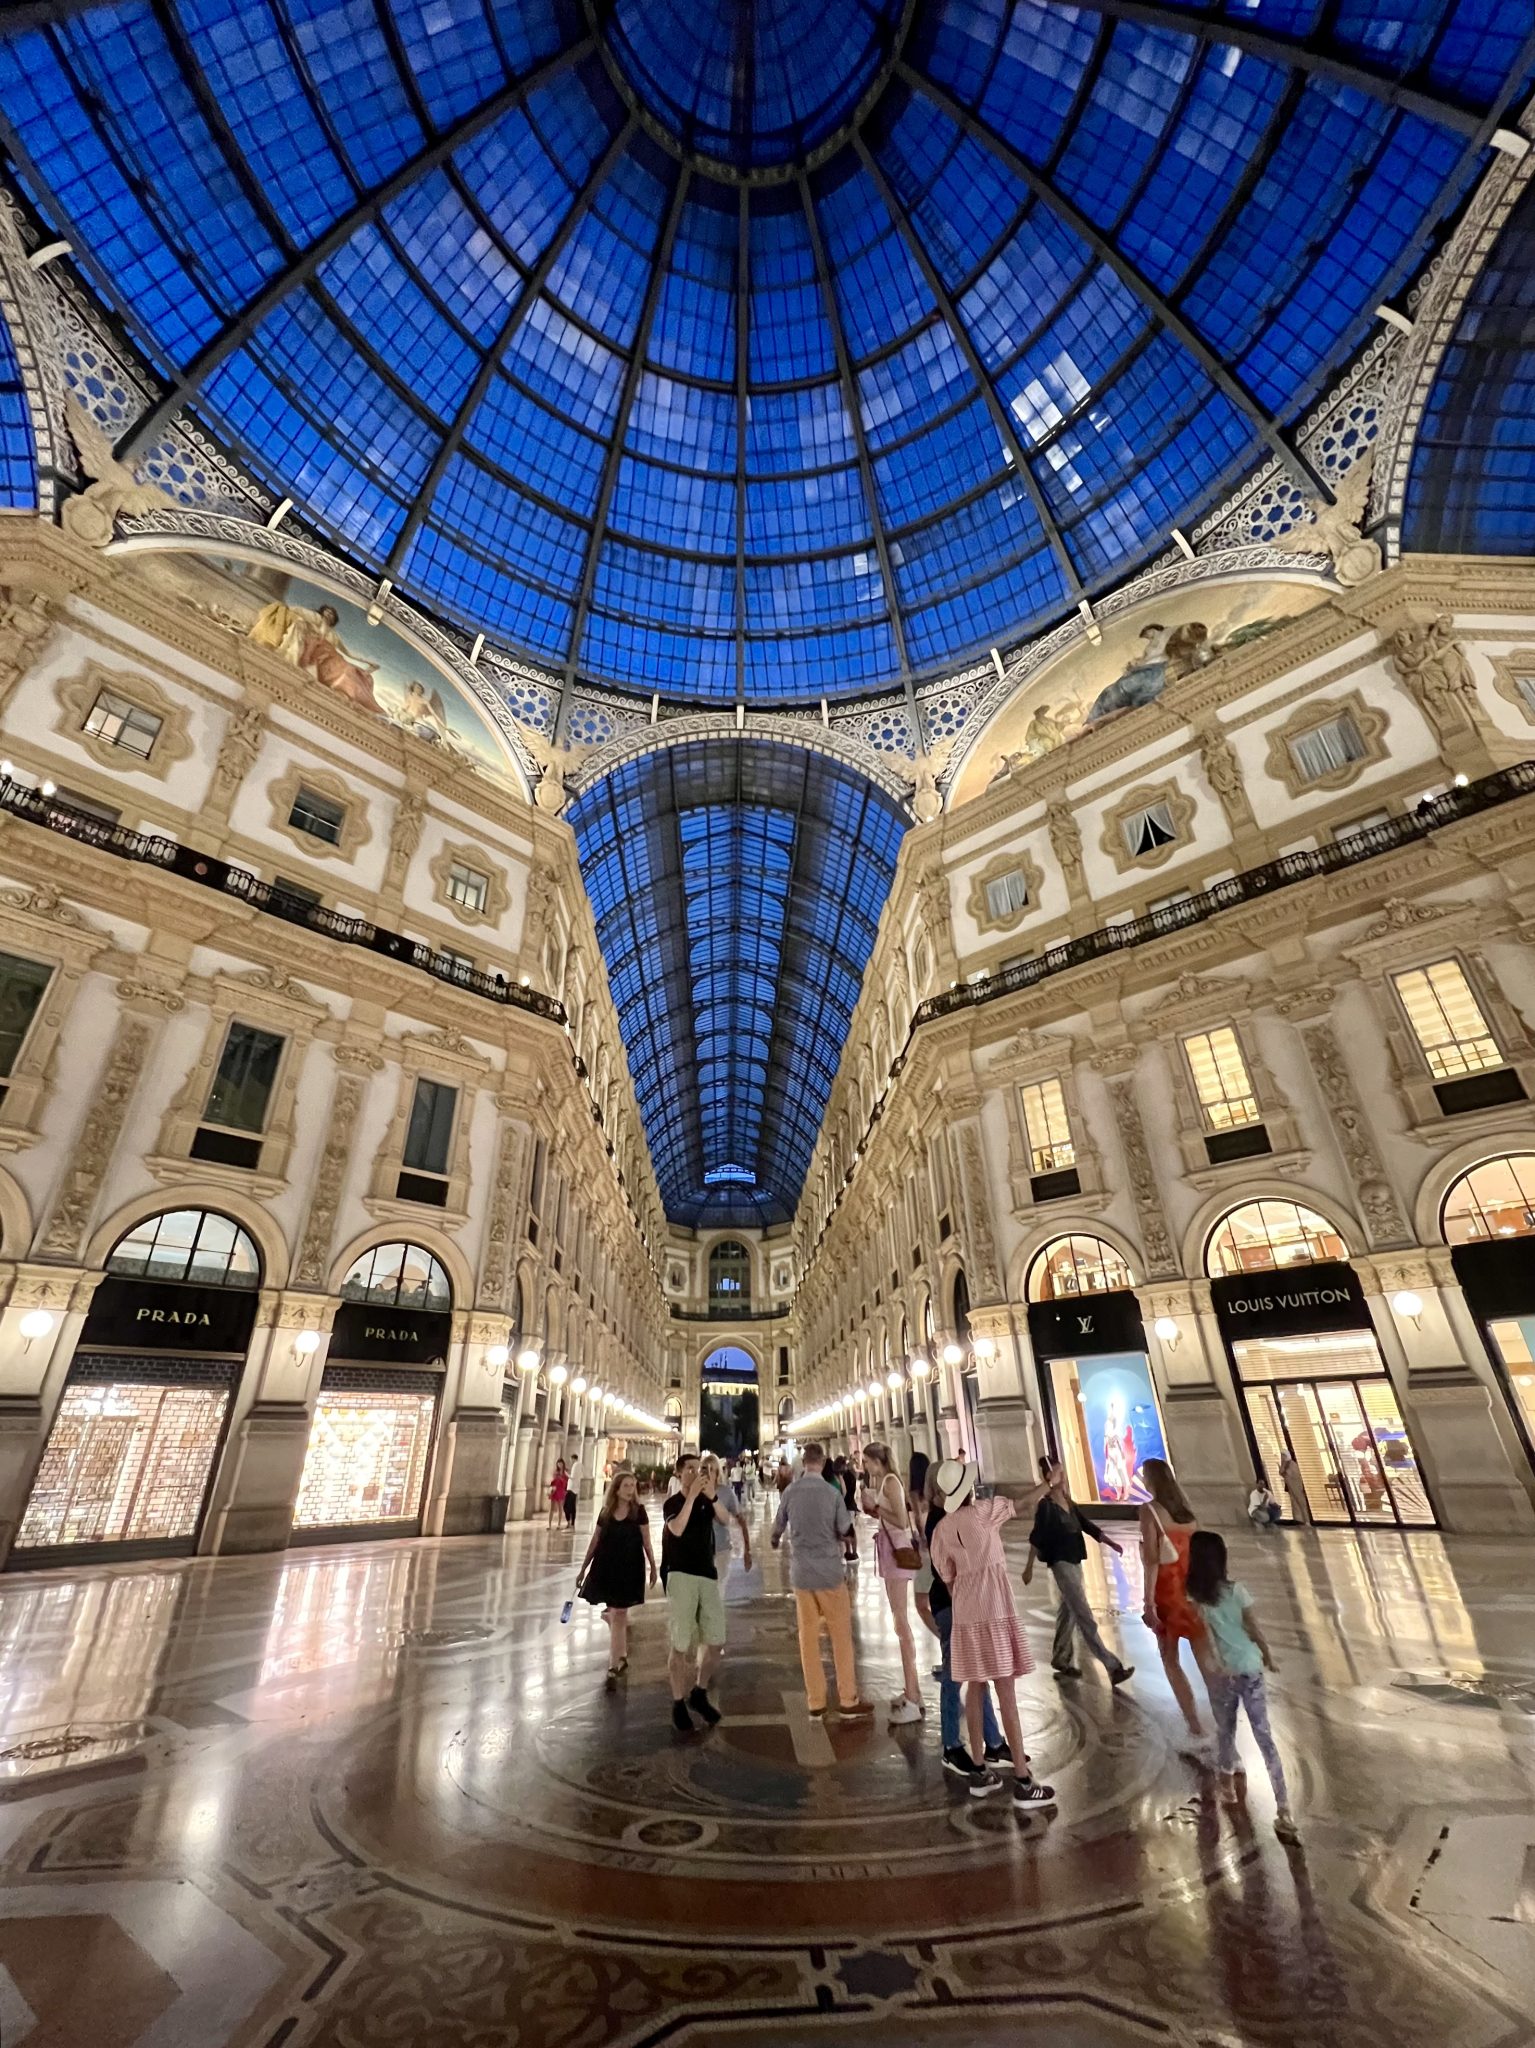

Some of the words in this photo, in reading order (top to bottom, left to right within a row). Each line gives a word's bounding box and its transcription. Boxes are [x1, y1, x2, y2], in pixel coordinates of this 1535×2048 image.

[1228, 1297, 1274, 1314] LOUIS
[1275, 1287, 1351, 1309] VUITTON
[136, 1308, 211, 1326] PRADA
[365, 1327, 419, 1342] PRADA
